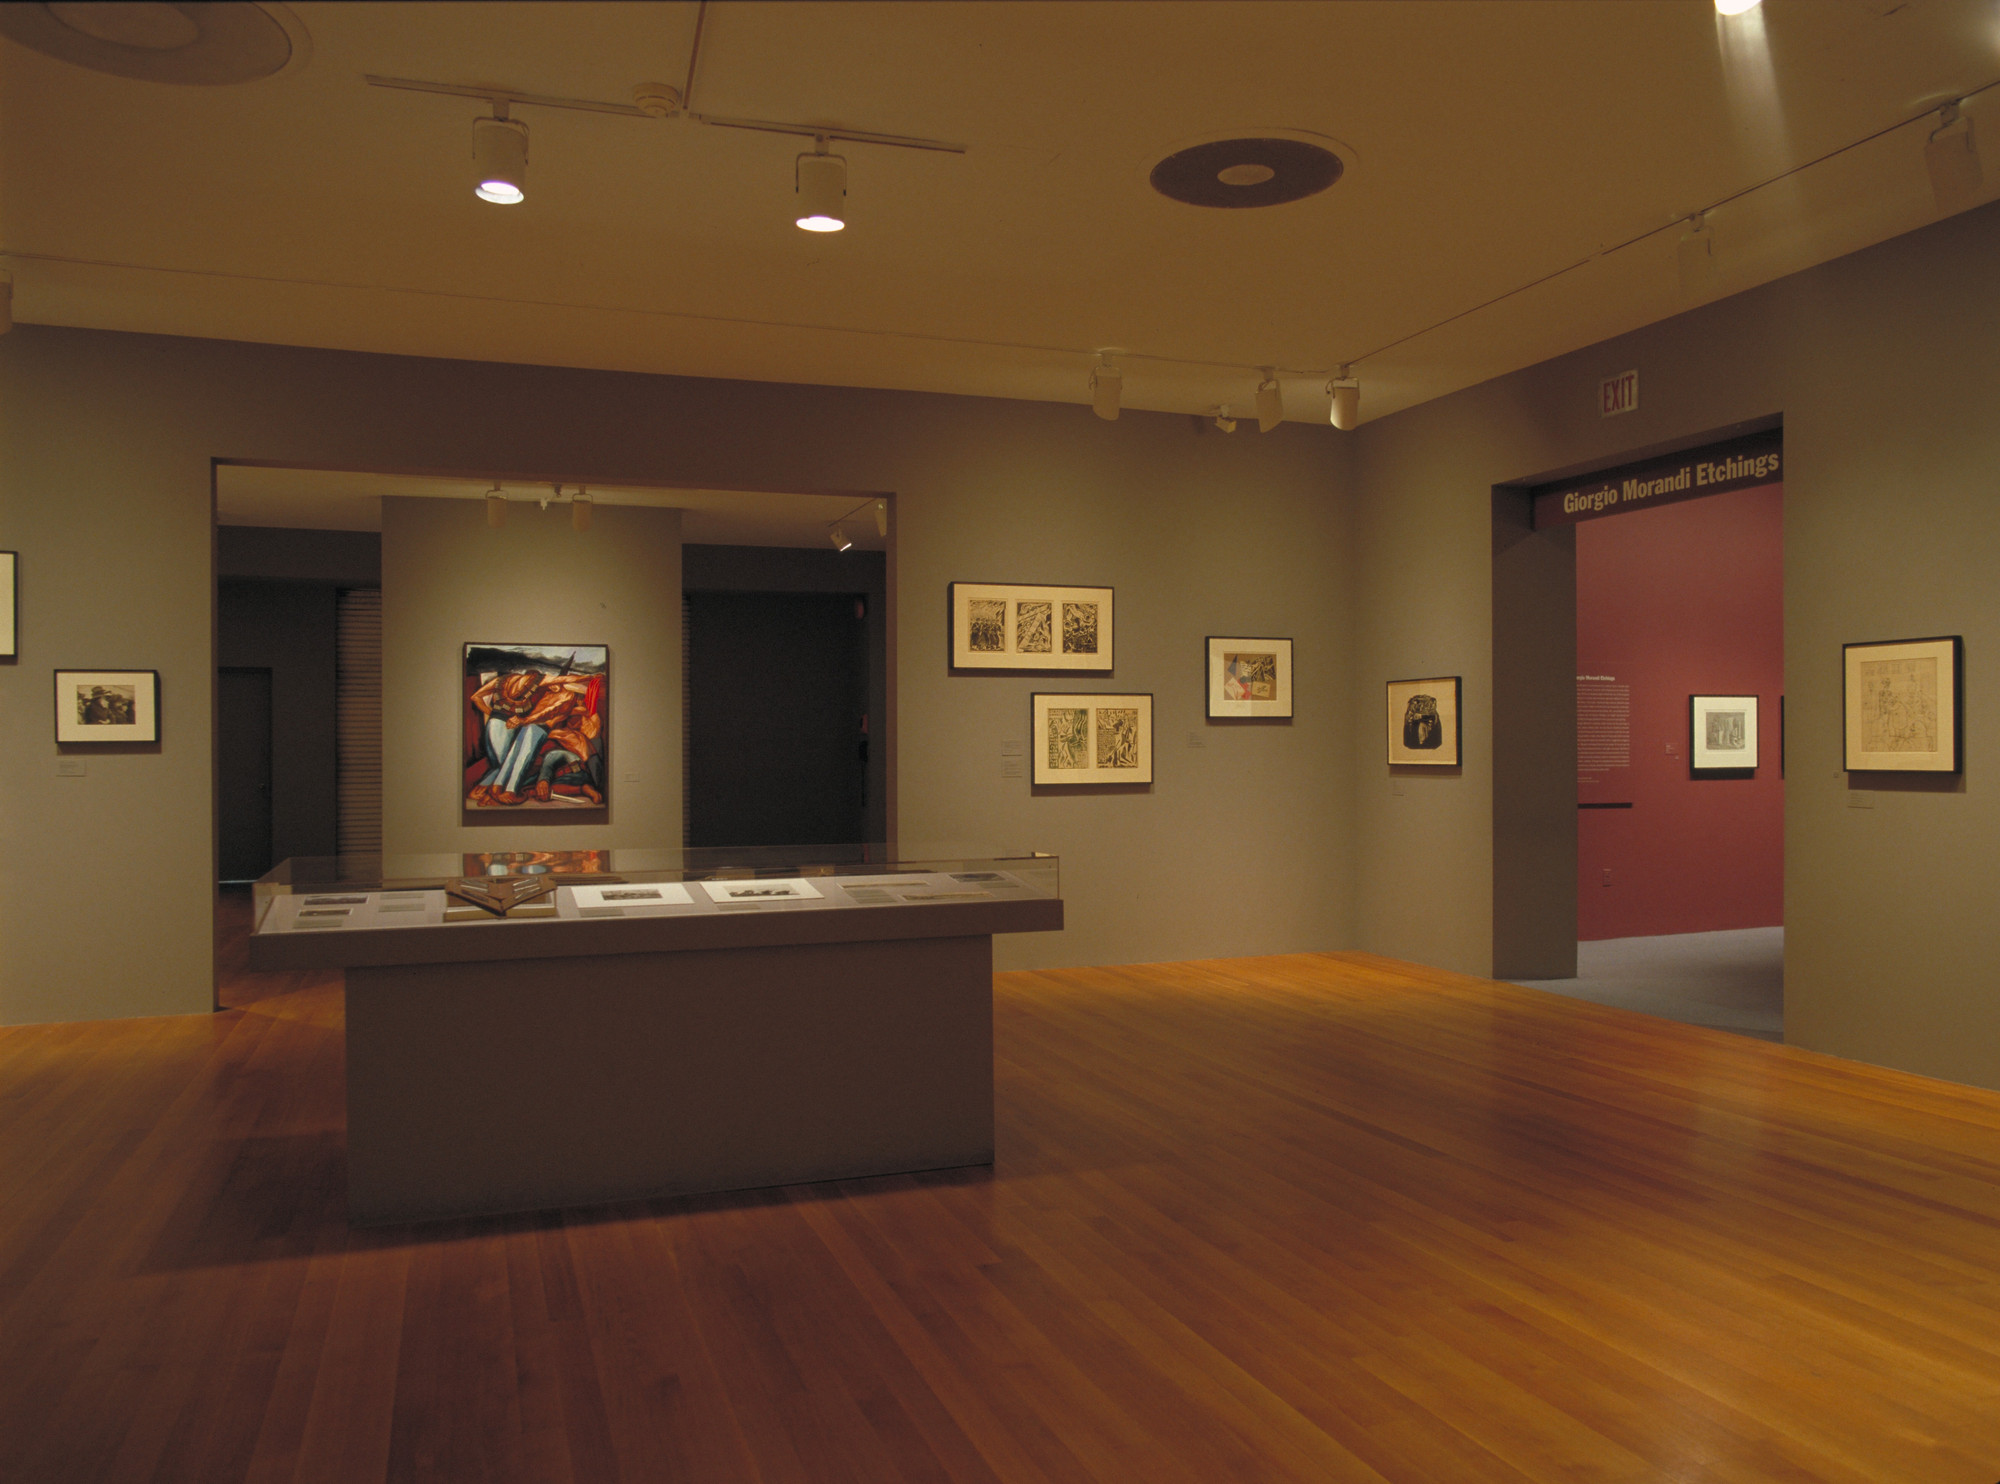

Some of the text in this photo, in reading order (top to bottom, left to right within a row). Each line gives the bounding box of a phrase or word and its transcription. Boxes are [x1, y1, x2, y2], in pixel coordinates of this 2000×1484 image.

[1603, 374, 1635, 413] EXIT
[1563, 453, 1779, 514] Giorgio Morandi Etchings
